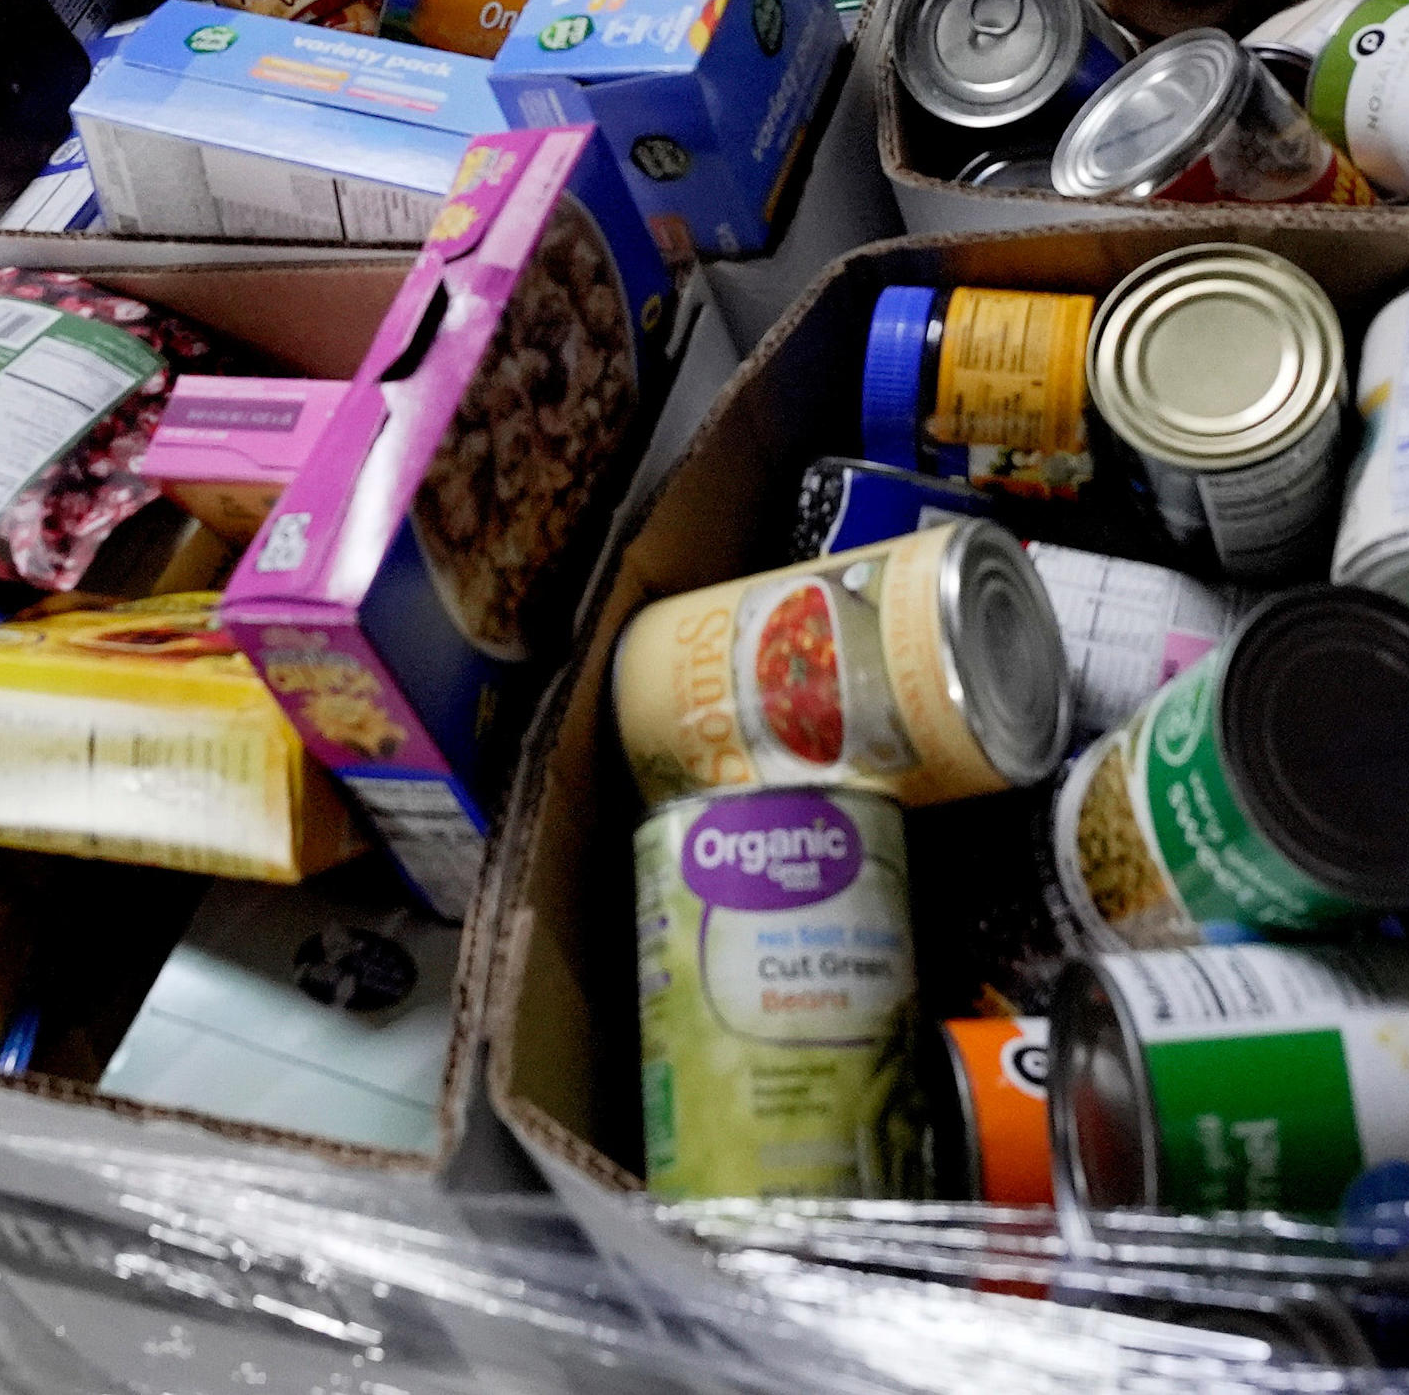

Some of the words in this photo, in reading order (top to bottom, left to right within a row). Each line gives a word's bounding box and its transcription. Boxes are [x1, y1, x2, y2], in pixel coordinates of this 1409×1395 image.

[293, 36, 387, 64] variety
[385, 55, 453, 78] pack
[675, 607, 752, 785] SOUPS
[693, 817, 848, 875] Organic
[757, 955, 812, 982] Cut
